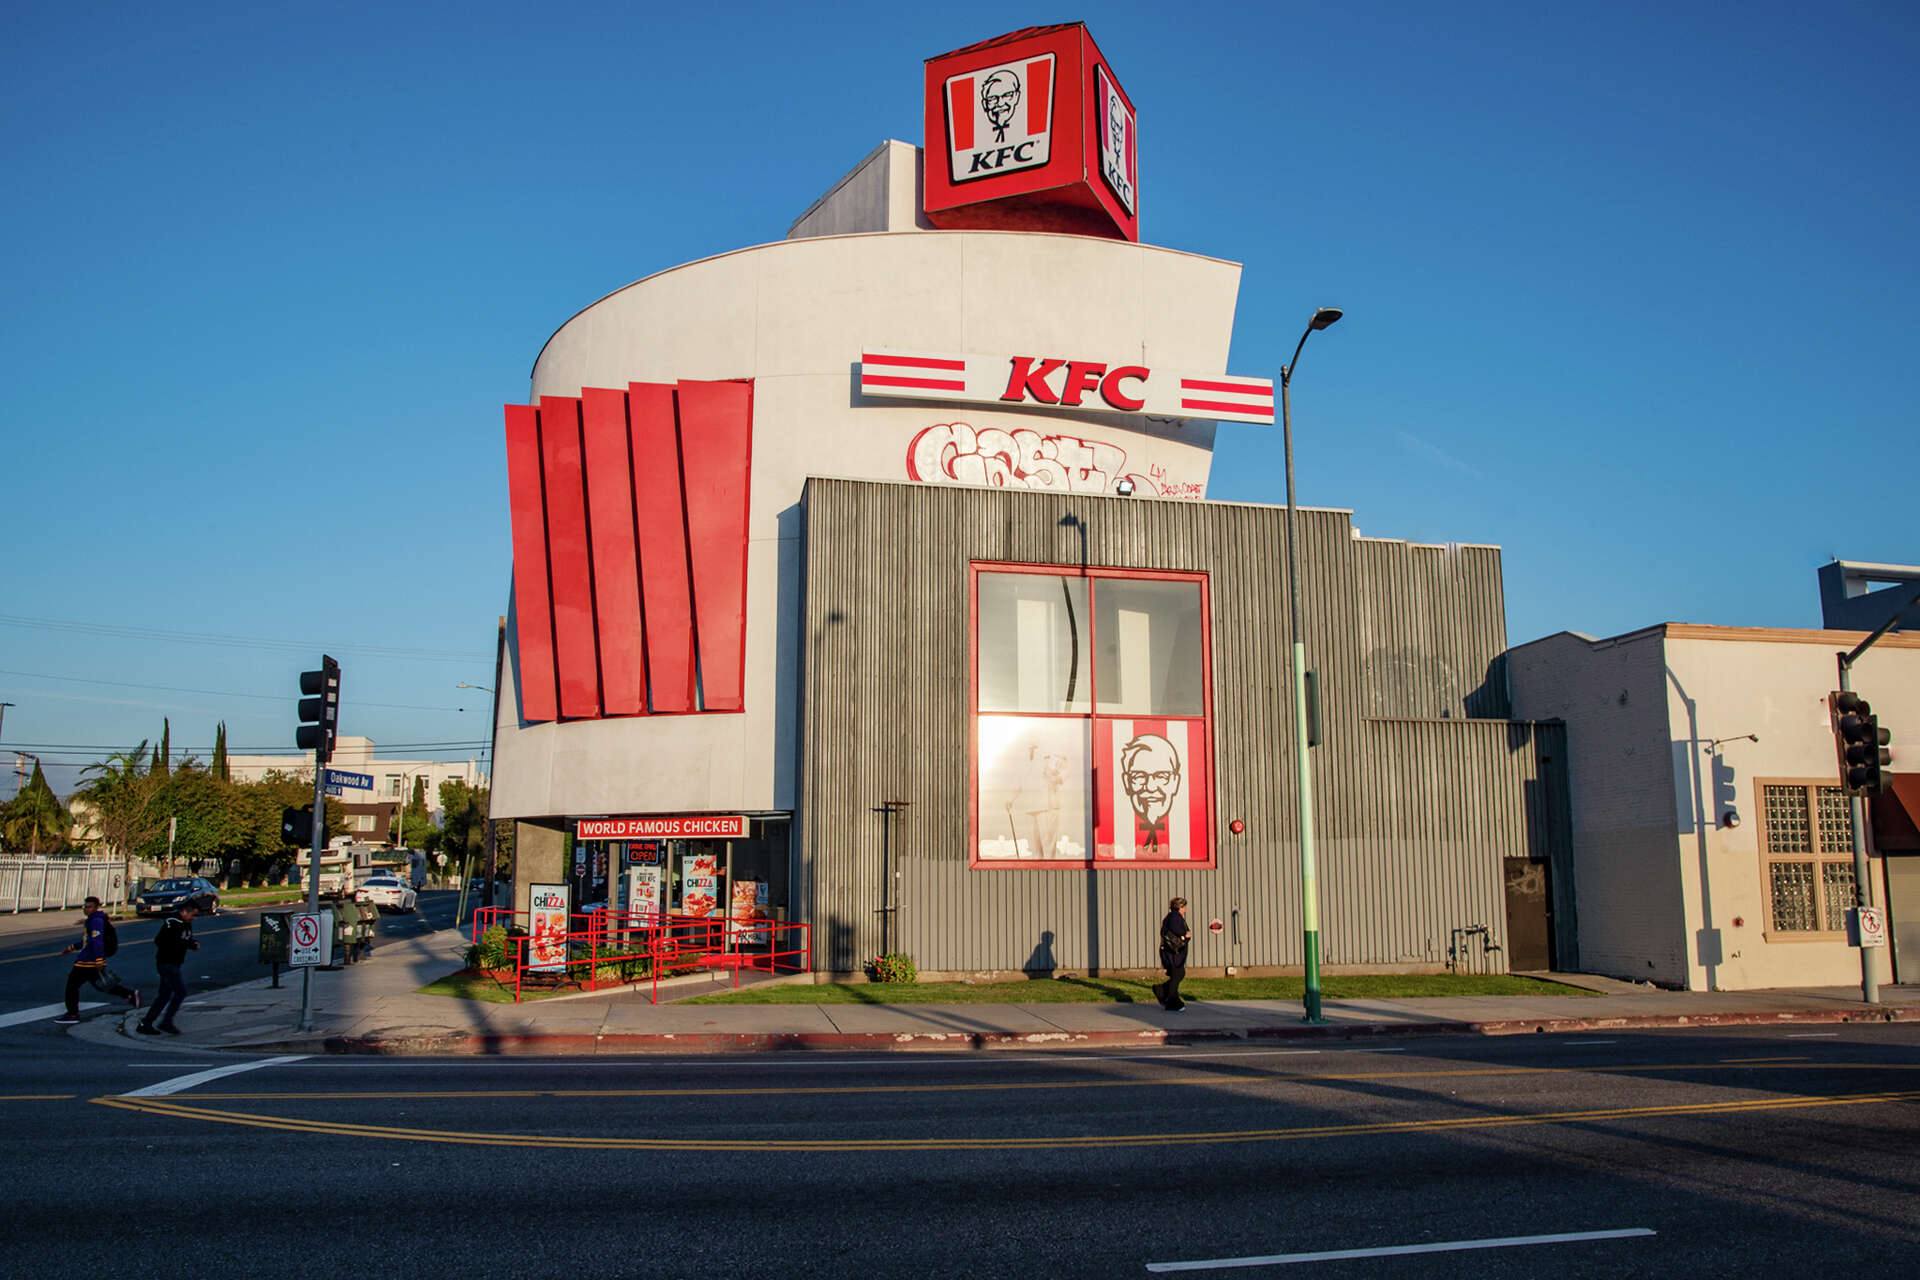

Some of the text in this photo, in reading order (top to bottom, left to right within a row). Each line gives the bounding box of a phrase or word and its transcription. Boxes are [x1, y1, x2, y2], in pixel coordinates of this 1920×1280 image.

[968, 140, 1034, 174] KFC
[1108, 160, 1131, 206] KFC
[1000, 356, 1150, 411] KFC
[331, 771, 369, 787] Oakwood Av
[583, 820, 739, 834] WORLD FAMOUS CHICKEN
[630, 850, 657, 861] OPEN
[686, 878, 713, 888] CHIZZA
[534, 896, 565, 908] CHIZZA
